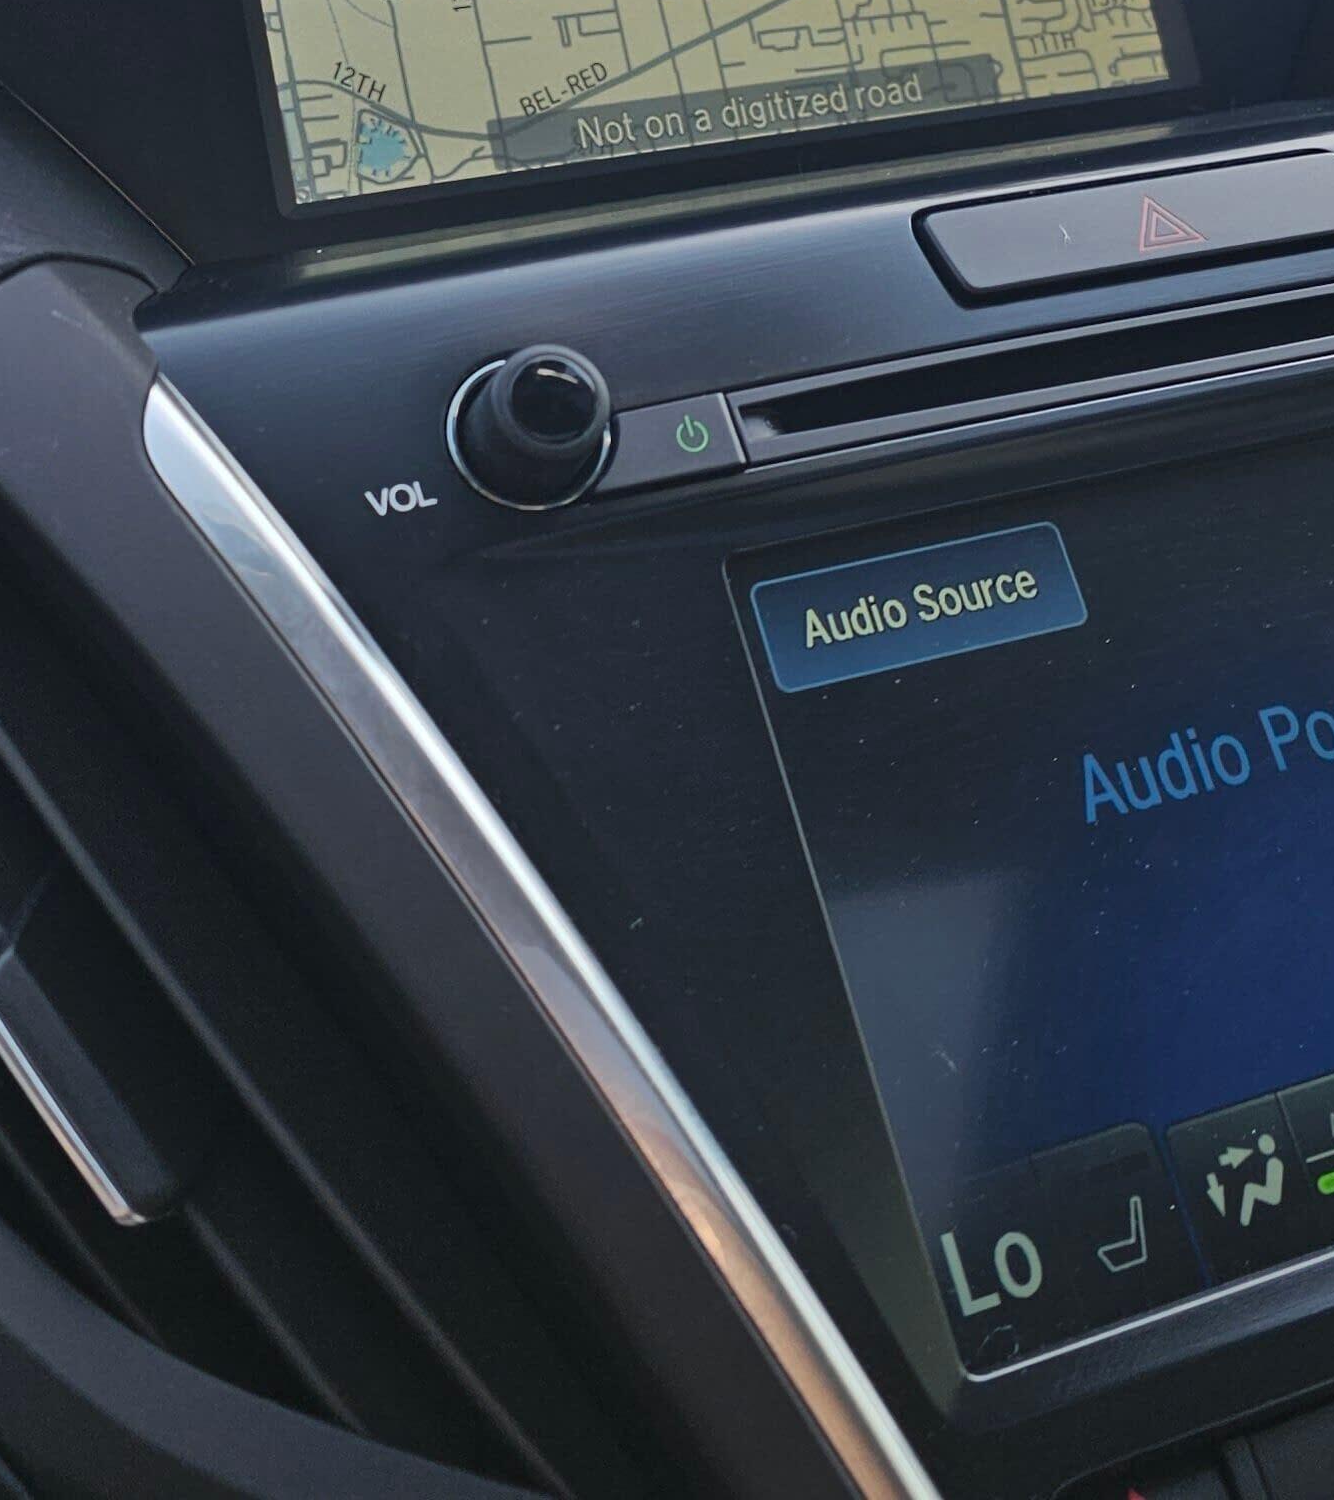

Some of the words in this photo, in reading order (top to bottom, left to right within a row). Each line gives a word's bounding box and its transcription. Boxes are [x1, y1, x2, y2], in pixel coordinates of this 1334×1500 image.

[332, 61, 387, 102] 12TH
[519, 62, 607, 116] BEL-RED
[576, 111, 636, 149] Not
[645, 112, 685, 138] on
[695, 108, 713, 132] a
[721, 84, 849, 130] digitized
[854, 73, 924, 111] road
[364, 480, 438, 518] VOL
[803, 596, 909, 651] Audio
[912, 564, 1040, 624] Source
[1082, 724, 1250, 824] Audio
